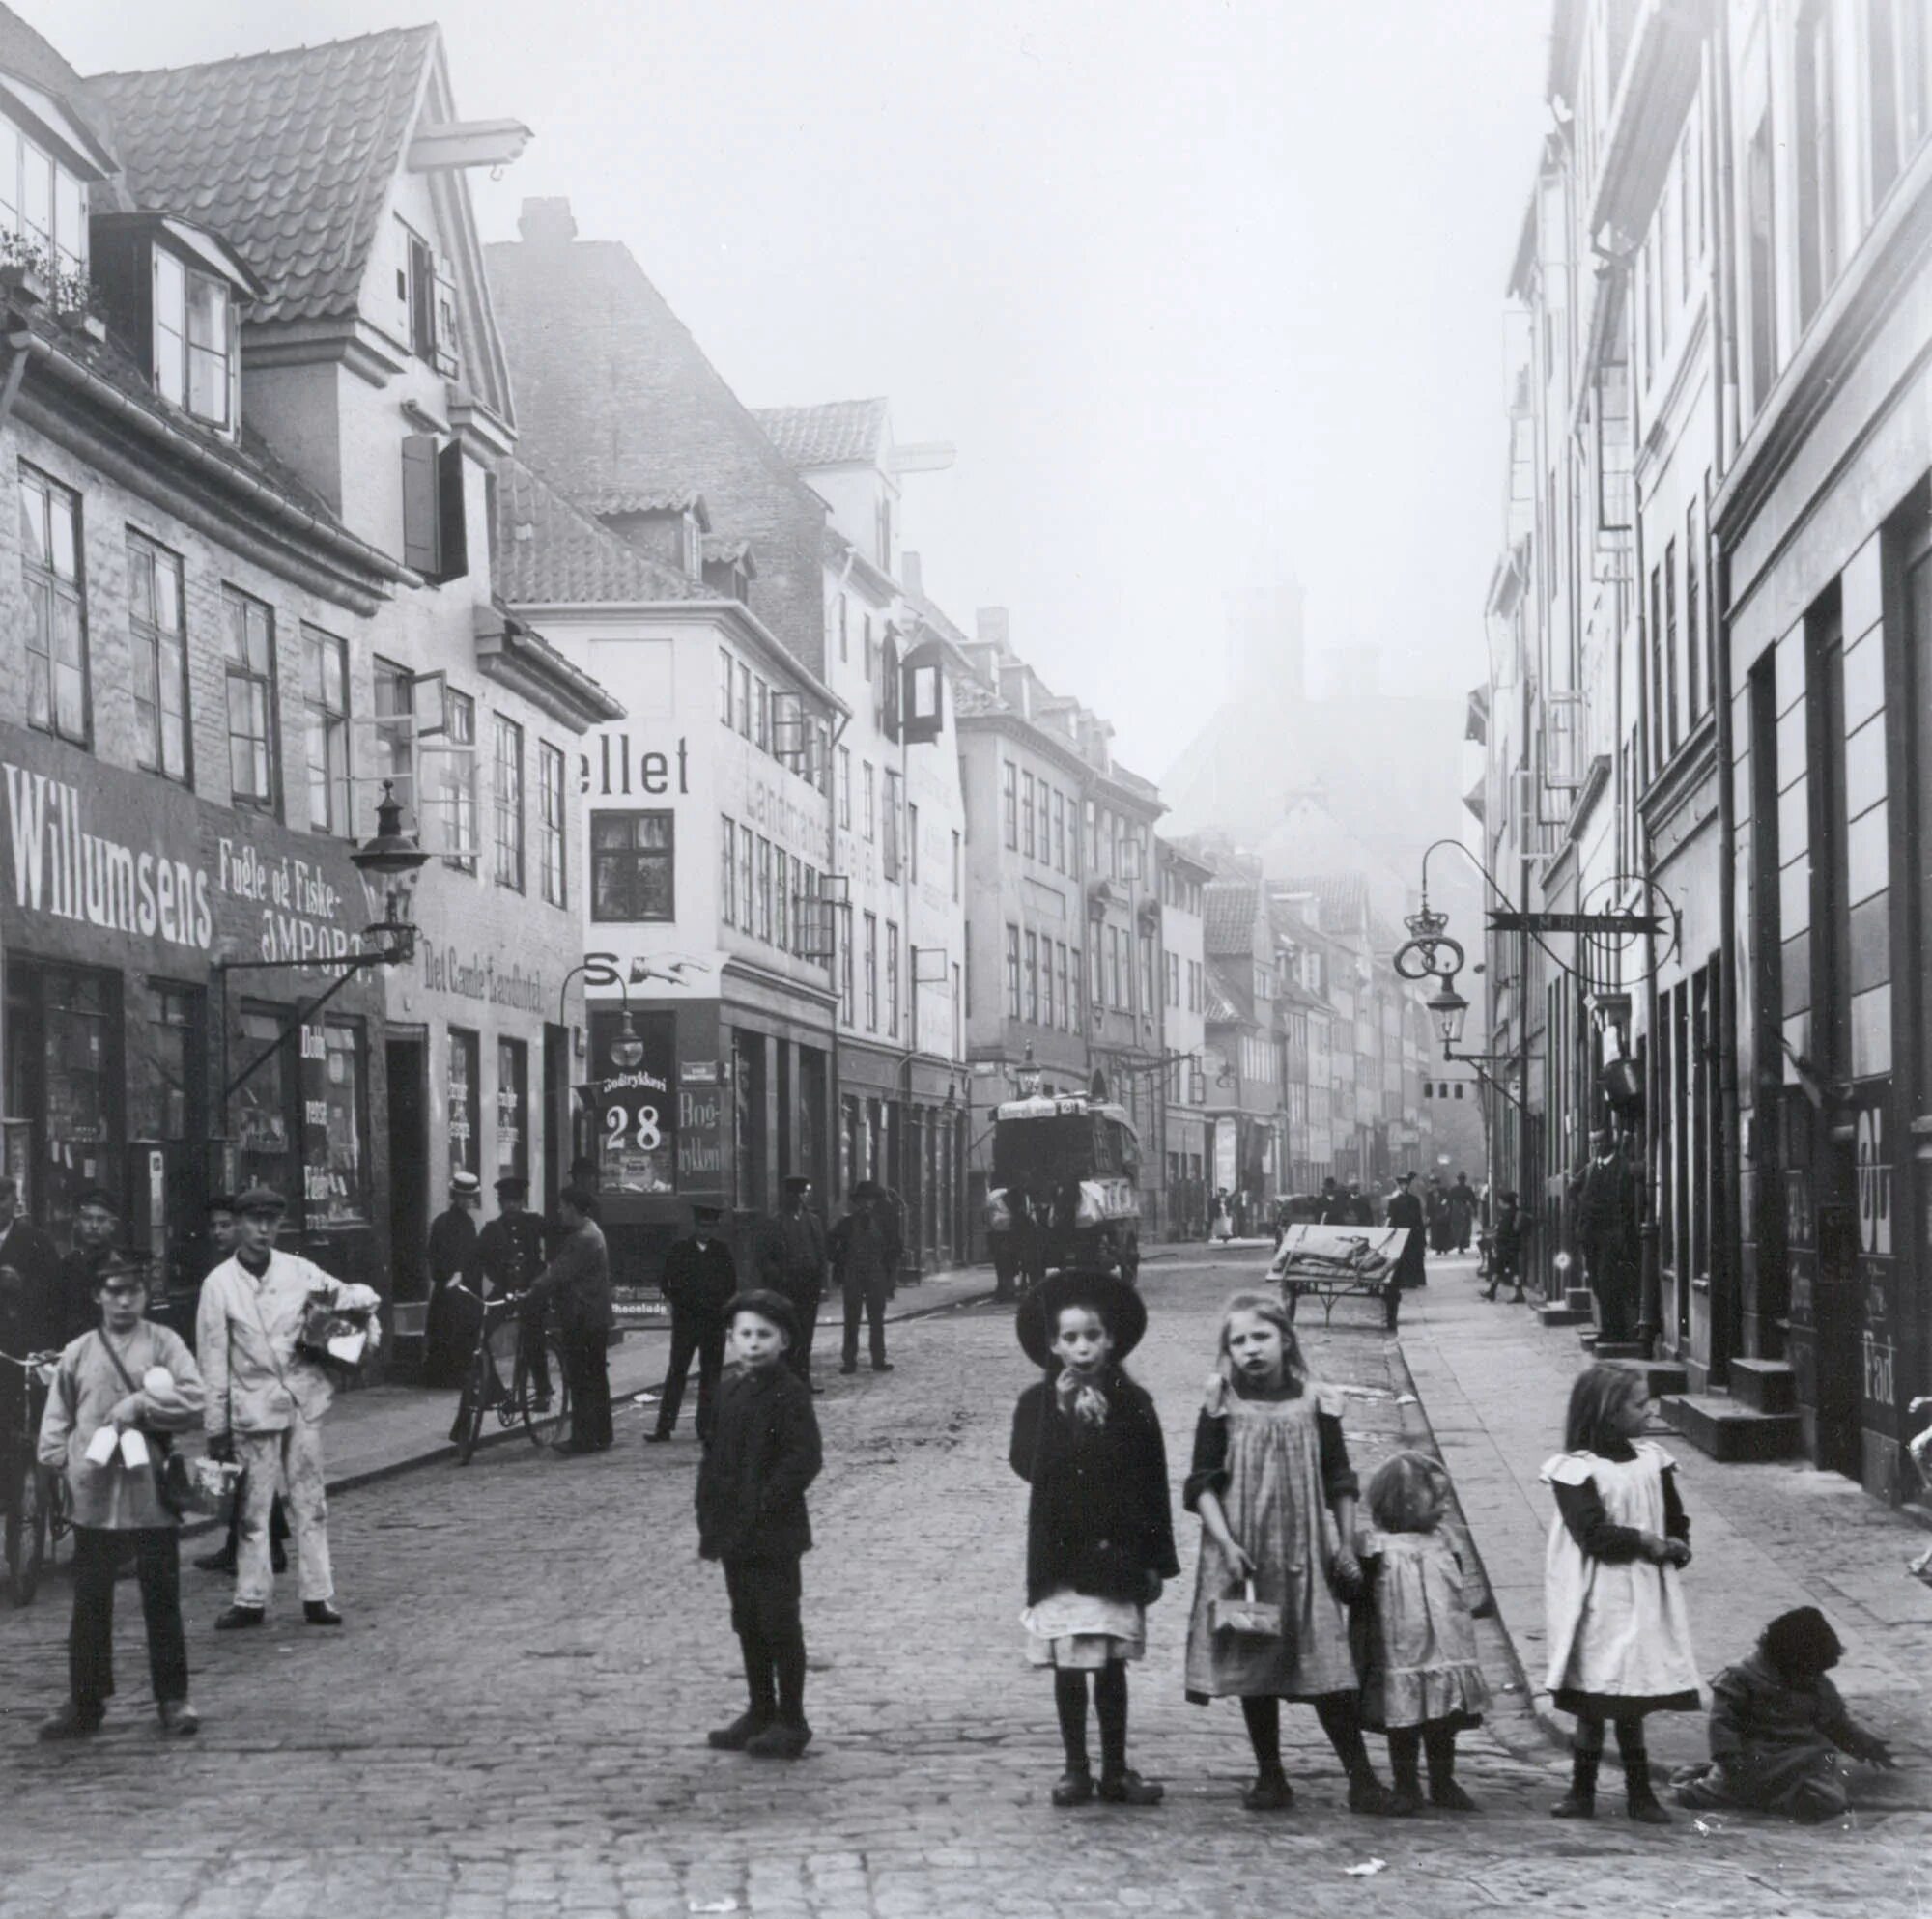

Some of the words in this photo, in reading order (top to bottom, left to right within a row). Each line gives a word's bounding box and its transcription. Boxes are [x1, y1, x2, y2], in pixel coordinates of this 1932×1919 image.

[2, 762, 212, 949] Willumsens
[219, 837, 267, 902] Fugle
[272, 856, 291, 910] og
[294, 859, 342, 919] Fiske-
[423, 939, 447, 993] Det
[606, 1105, 661, 1151] 28
